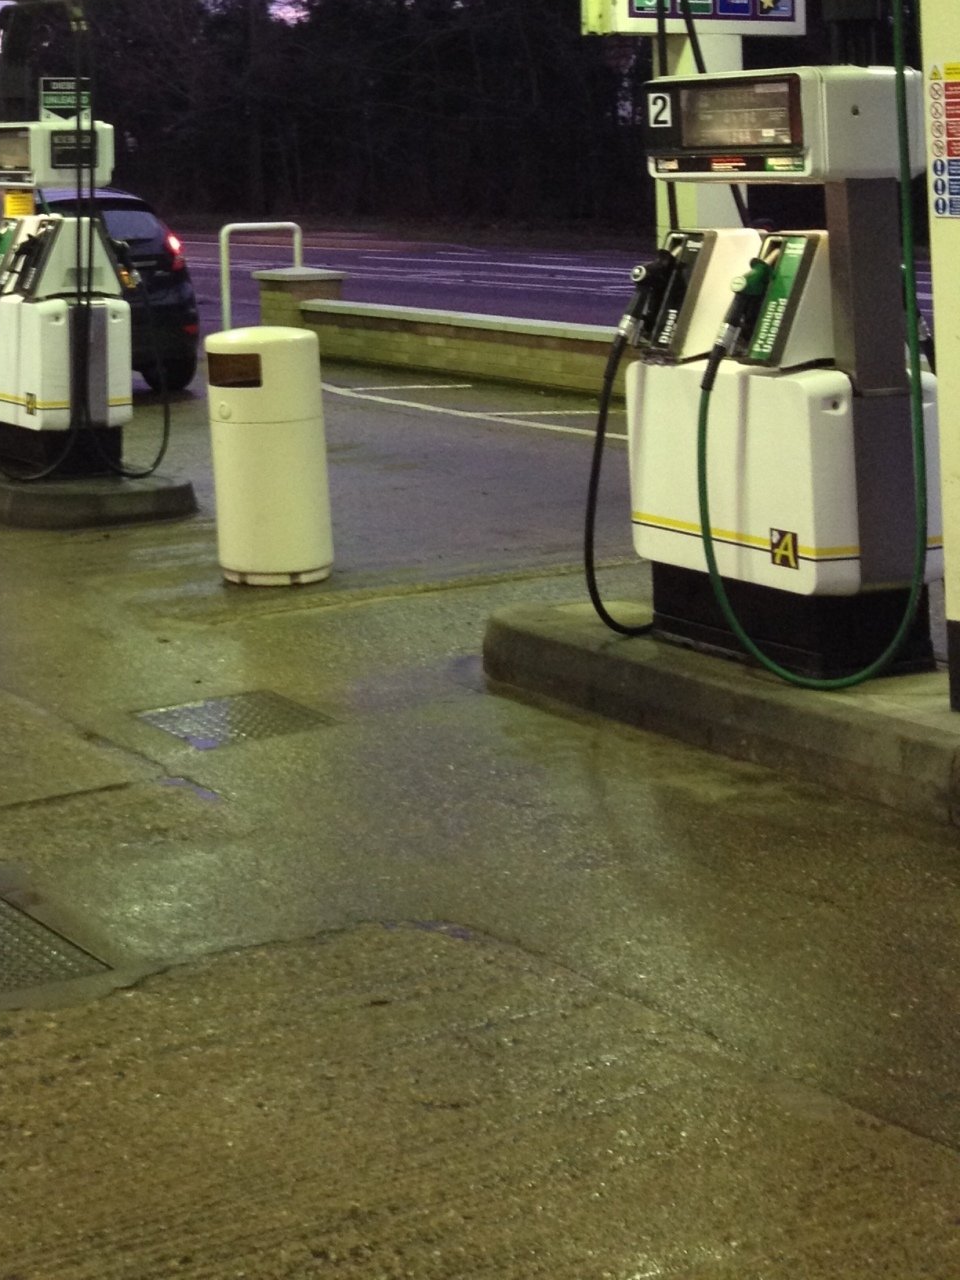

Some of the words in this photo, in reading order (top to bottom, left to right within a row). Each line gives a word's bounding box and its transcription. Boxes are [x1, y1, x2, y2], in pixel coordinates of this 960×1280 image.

[652, 95, 669, 125] 2
[658, 309, 679, 345] Diesel
[752, 301, 778, 352] Premium
[762, 297, 789, 353] Unleaded
